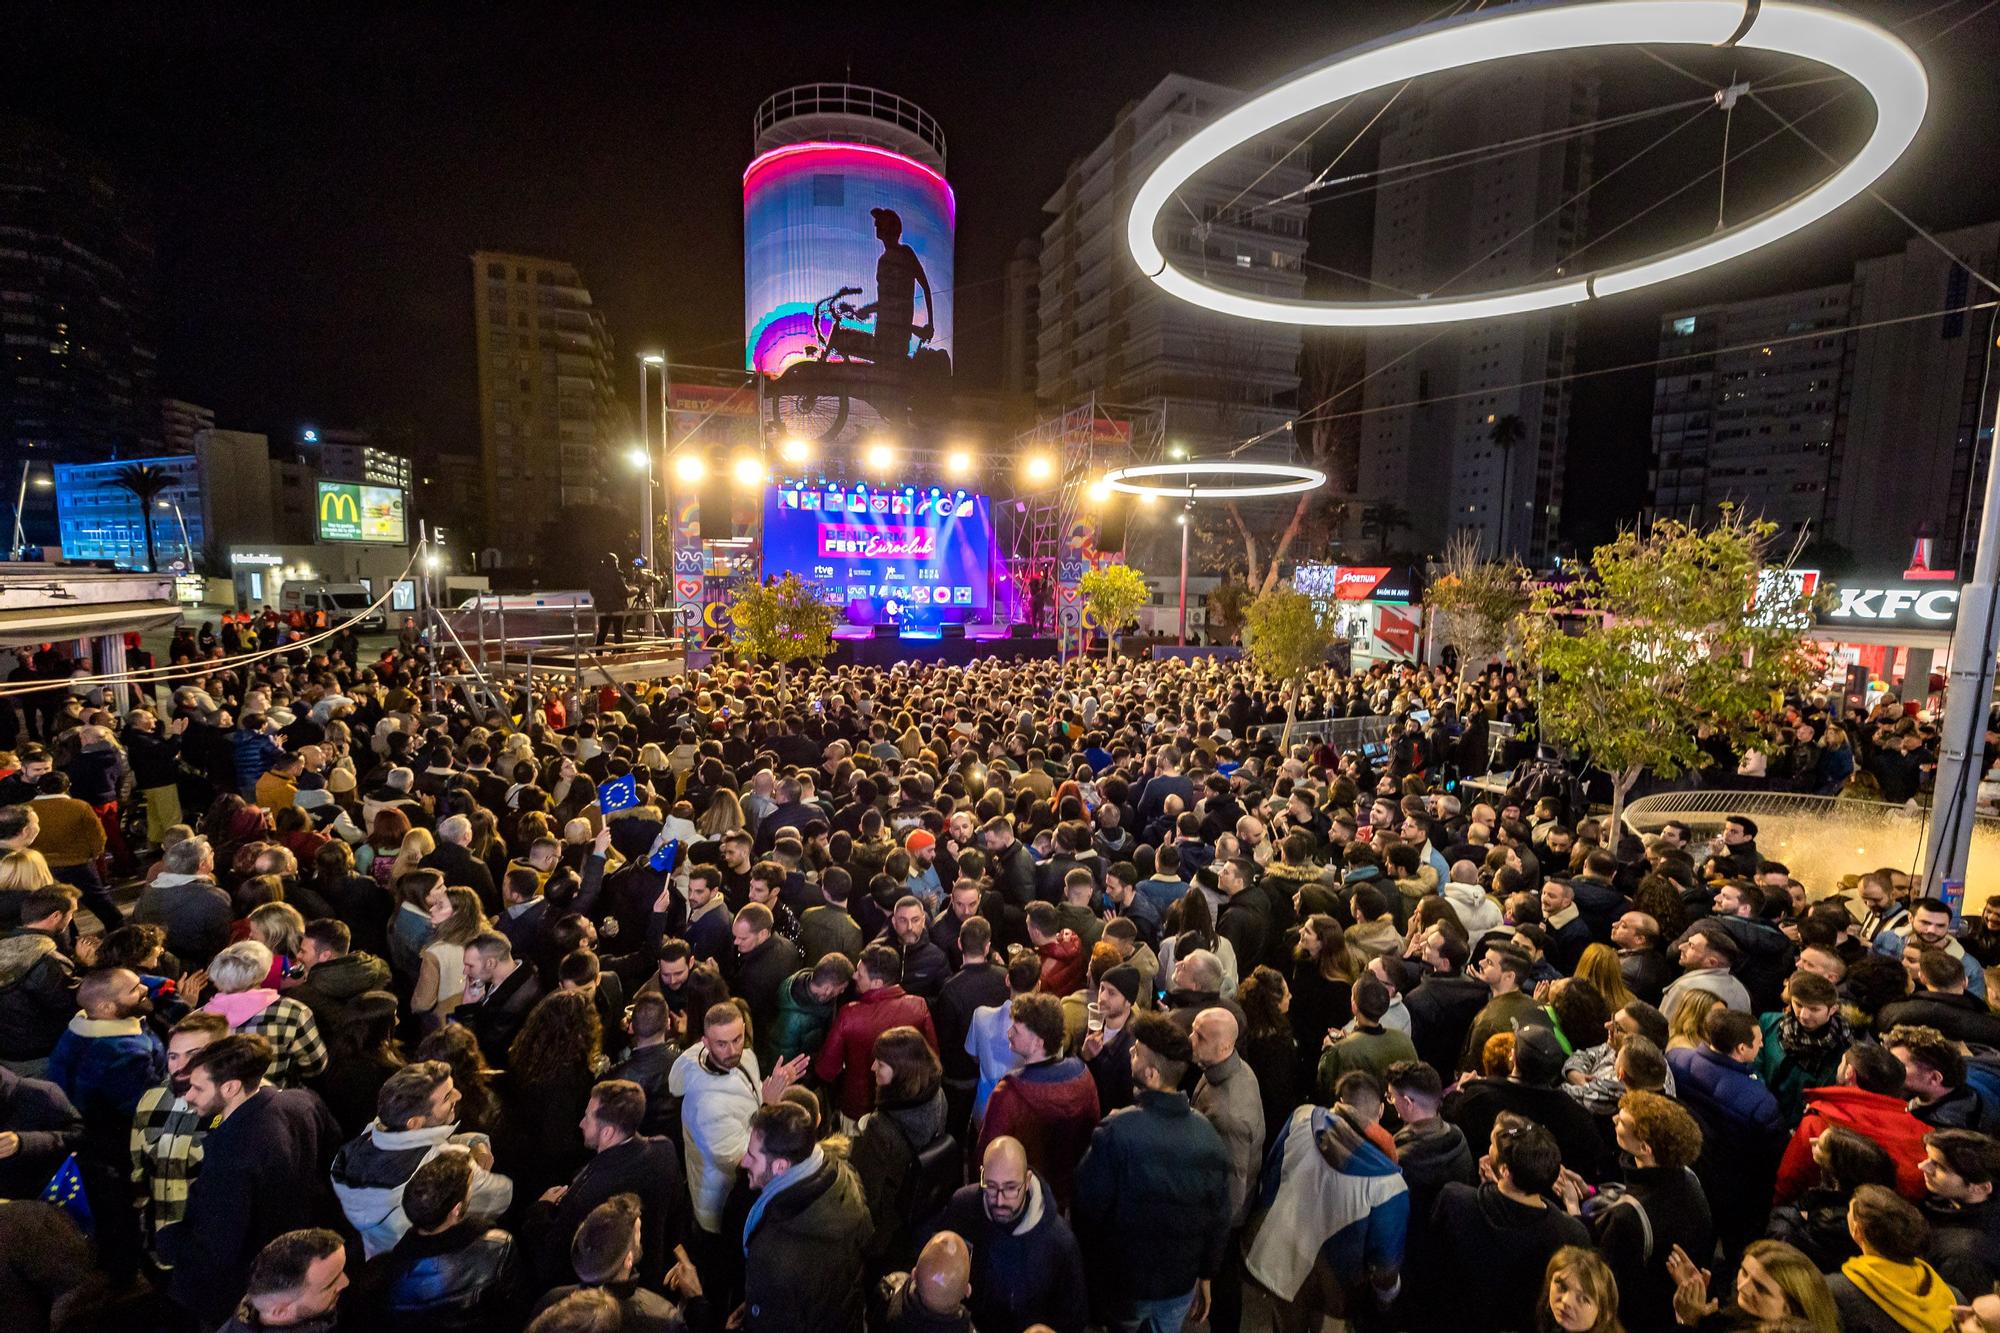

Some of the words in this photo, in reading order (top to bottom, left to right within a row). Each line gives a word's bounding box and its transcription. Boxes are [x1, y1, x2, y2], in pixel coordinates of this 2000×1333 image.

[826, 530, 907, 542] BENIDORM
[825, 540, 866, 552] FEST
[865, 536, 933, 556] Euroclub
[814, 565, 833, 575] rtve
[1338, 572, 1376, 584] SPORTIUM
[1831, 588, 1960, 620] KFC
